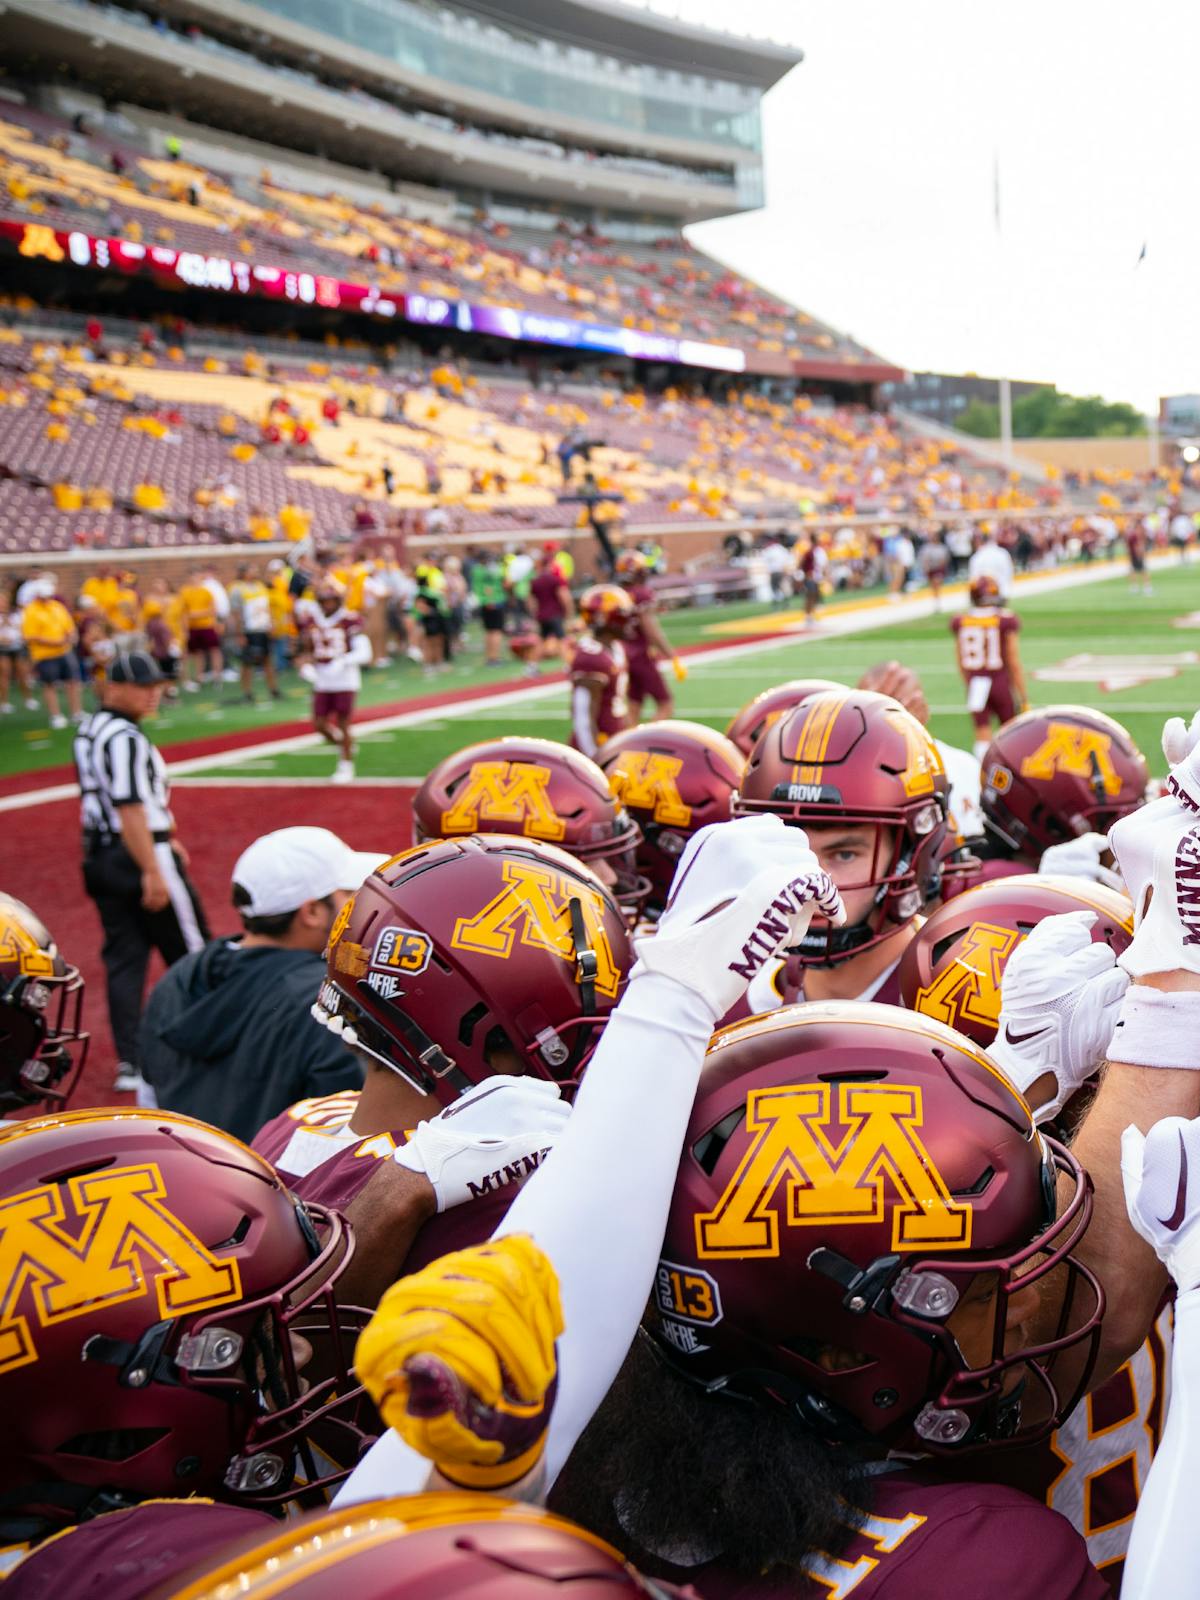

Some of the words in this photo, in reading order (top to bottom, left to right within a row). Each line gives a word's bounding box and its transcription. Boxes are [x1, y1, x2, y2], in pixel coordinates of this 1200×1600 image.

[958, 627, 1004, 670] 81
[1020, 722, 1123, 796] M
[441, 761, 566, 842] M
[788, 784, 823, 803] ROW
[378, 932, 395, 963] BUD
[389, 934, 427, 970] 13
[451, 860, 621, 999] M
[693, 1082, 973, 1260] M
[659, 1268, 674, 1309] BUD
[671, 1272, 714, 1319] 13
